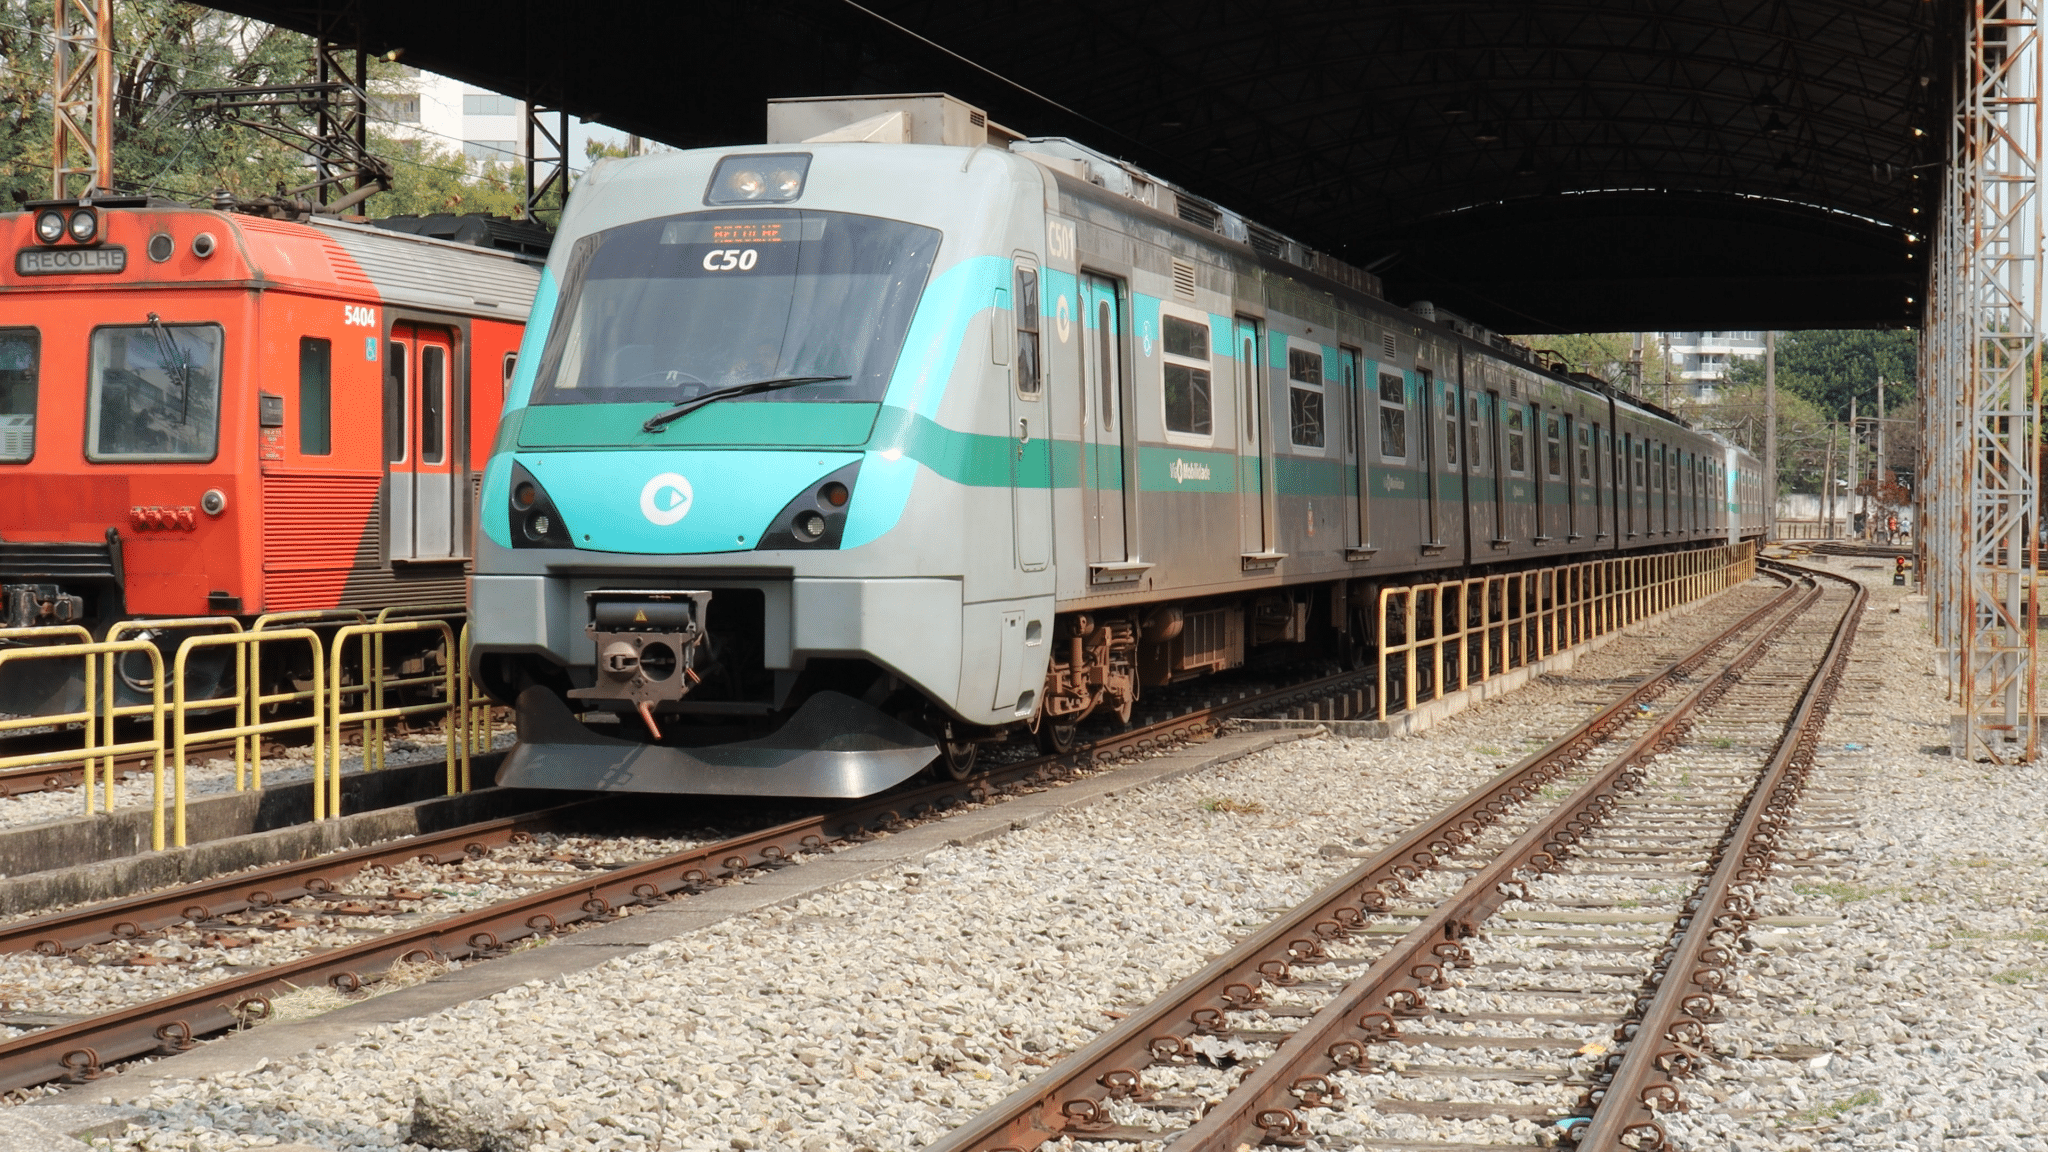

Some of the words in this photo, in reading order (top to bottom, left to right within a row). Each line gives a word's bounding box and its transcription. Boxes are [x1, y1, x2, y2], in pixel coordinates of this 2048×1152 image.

[1049, 221, 1074, 261] C501
[26, 251, 121, 267] RECOLHE
[703, 249, 758, 270] C50
[345, 304, 375, 327] 5404
